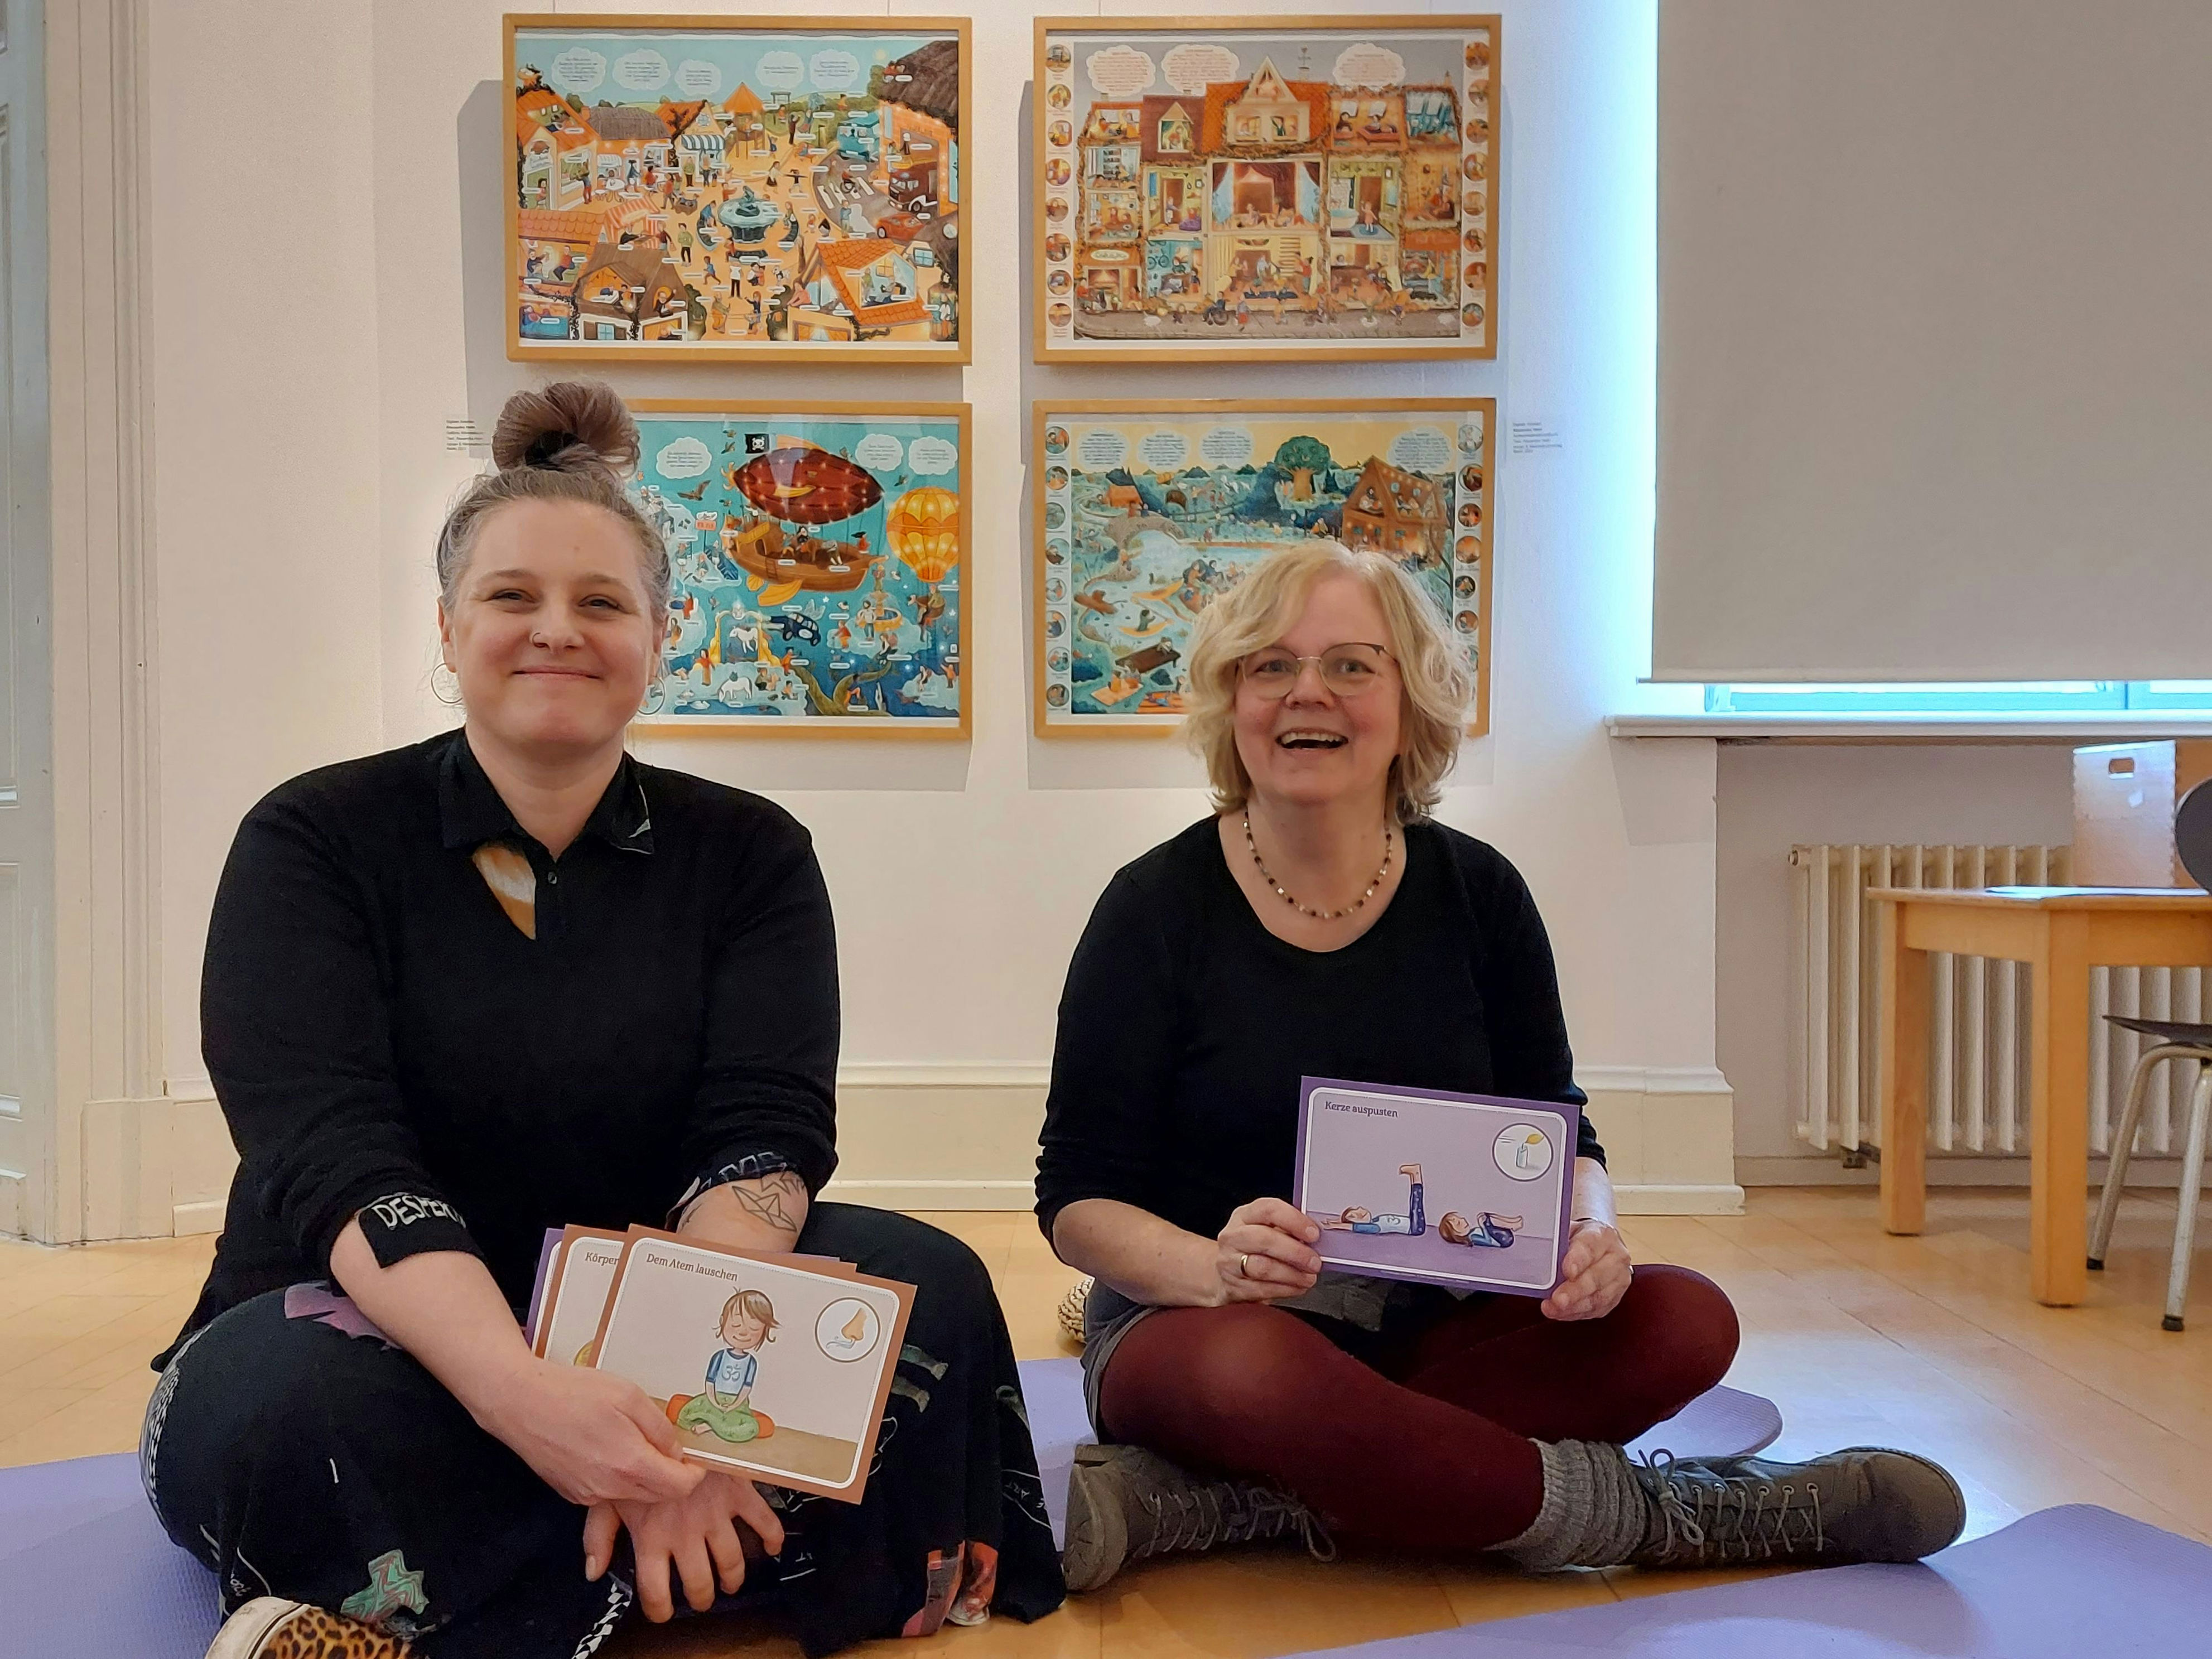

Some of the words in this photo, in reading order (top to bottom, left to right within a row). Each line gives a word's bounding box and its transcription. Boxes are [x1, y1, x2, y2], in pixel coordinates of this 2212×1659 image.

[1325, 1101, 1351, 1112] Kerze
[1352, 1106, 1398, 1117] auspusten
[646, 1253, 668, 1267] Dem
[668, 1258, 693, 1272] Atem
[695, 1263, 738, 1282] lauschen
